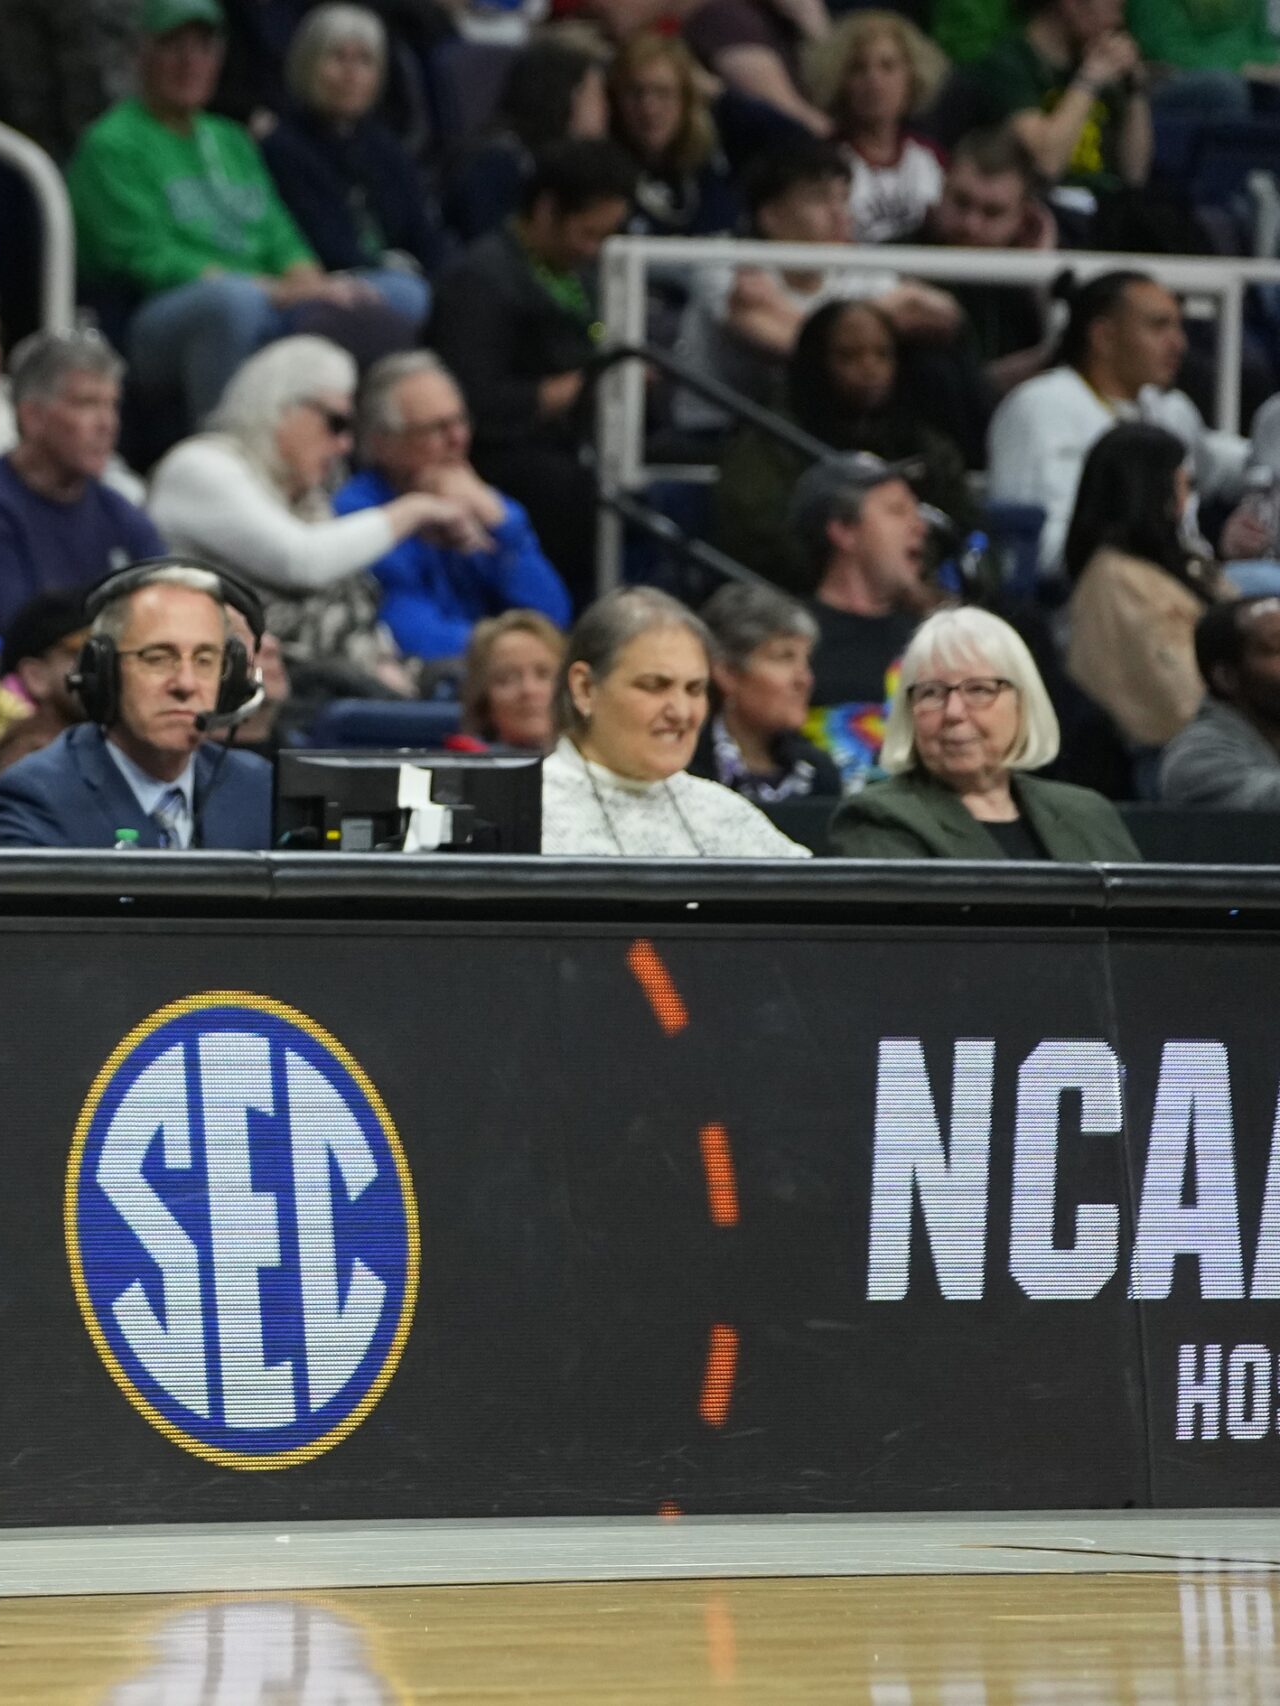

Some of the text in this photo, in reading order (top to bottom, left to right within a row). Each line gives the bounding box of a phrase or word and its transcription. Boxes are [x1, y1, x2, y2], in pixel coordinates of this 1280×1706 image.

[95, 1031, 388, 1429] SEC
[866, 1039, 1280, 1301] NCA
[1175, 1343, 1280, 1441] HO
